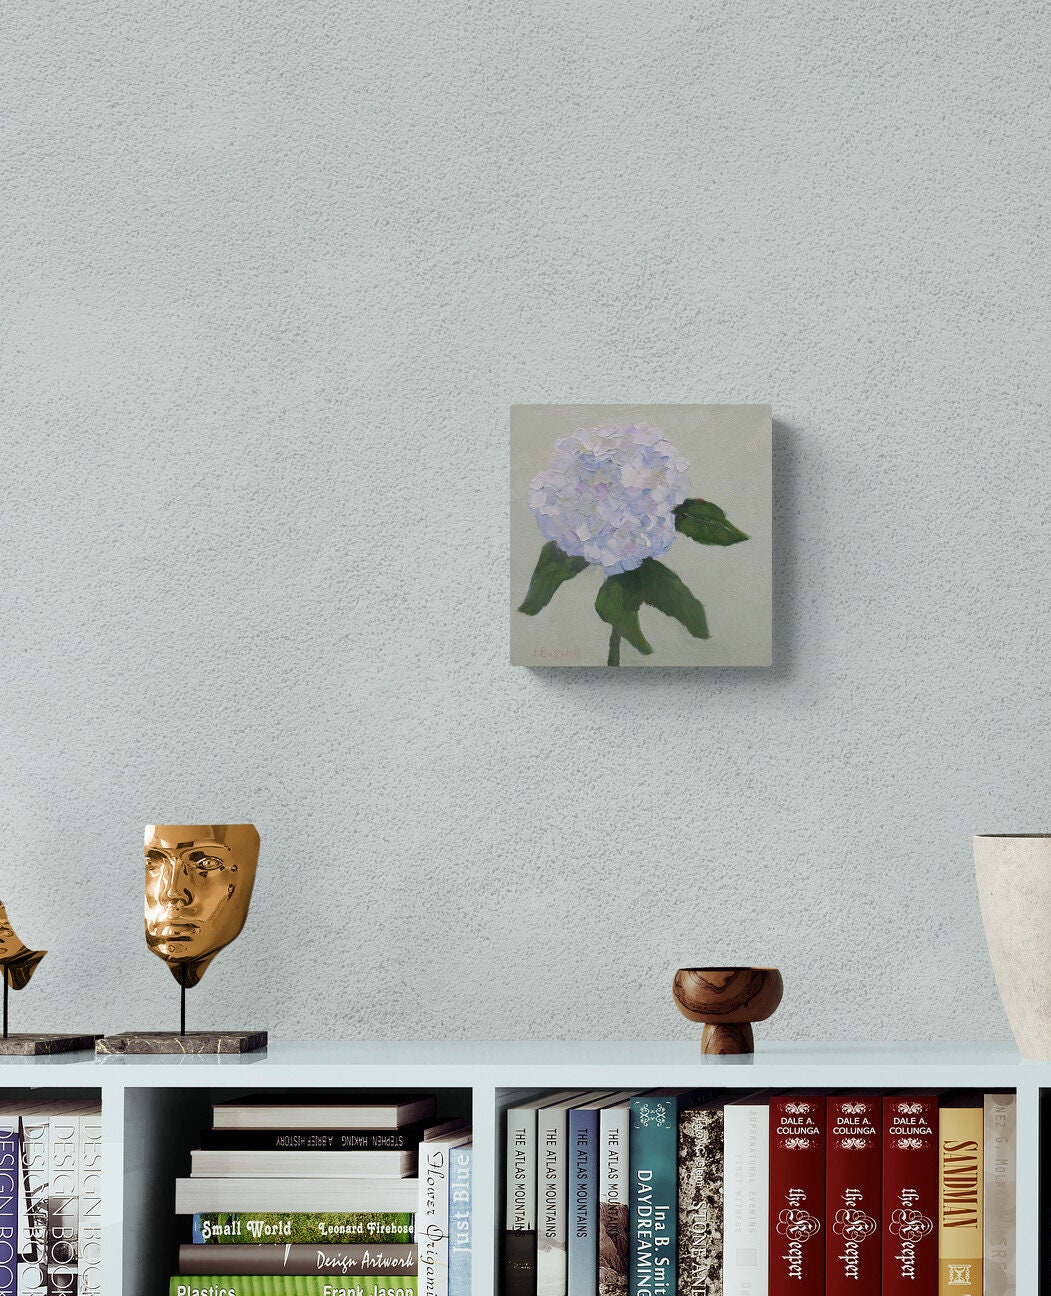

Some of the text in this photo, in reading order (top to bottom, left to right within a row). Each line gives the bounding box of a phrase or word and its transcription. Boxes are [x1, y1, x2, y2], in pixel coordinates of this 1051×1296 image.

[275, 1135, 404, 1147] STEPHEN HAKING A BRIEF HISTORY
[777, 1126, 820, 1135] COLUNGA
[52, 1125, 76, 1217] DESIGN
[423, 1151, 445, 1216] Flower
[546, 1128, 557, 1238] THE ATLAS MOUNTAINS
[943, 1140, 979, 1229] SANDMAN
[452, 1154, 470, 1254] Just Blue
[654, 1205, 669, 1231] Ina
[201, 1219, 414, 1239] Small World Leonard Firehose
[654, 1236, 669, 1253] B.
[690, 1200, 707, 1257] STONE
[316, 1249, 414, 1273] Design Artwork
